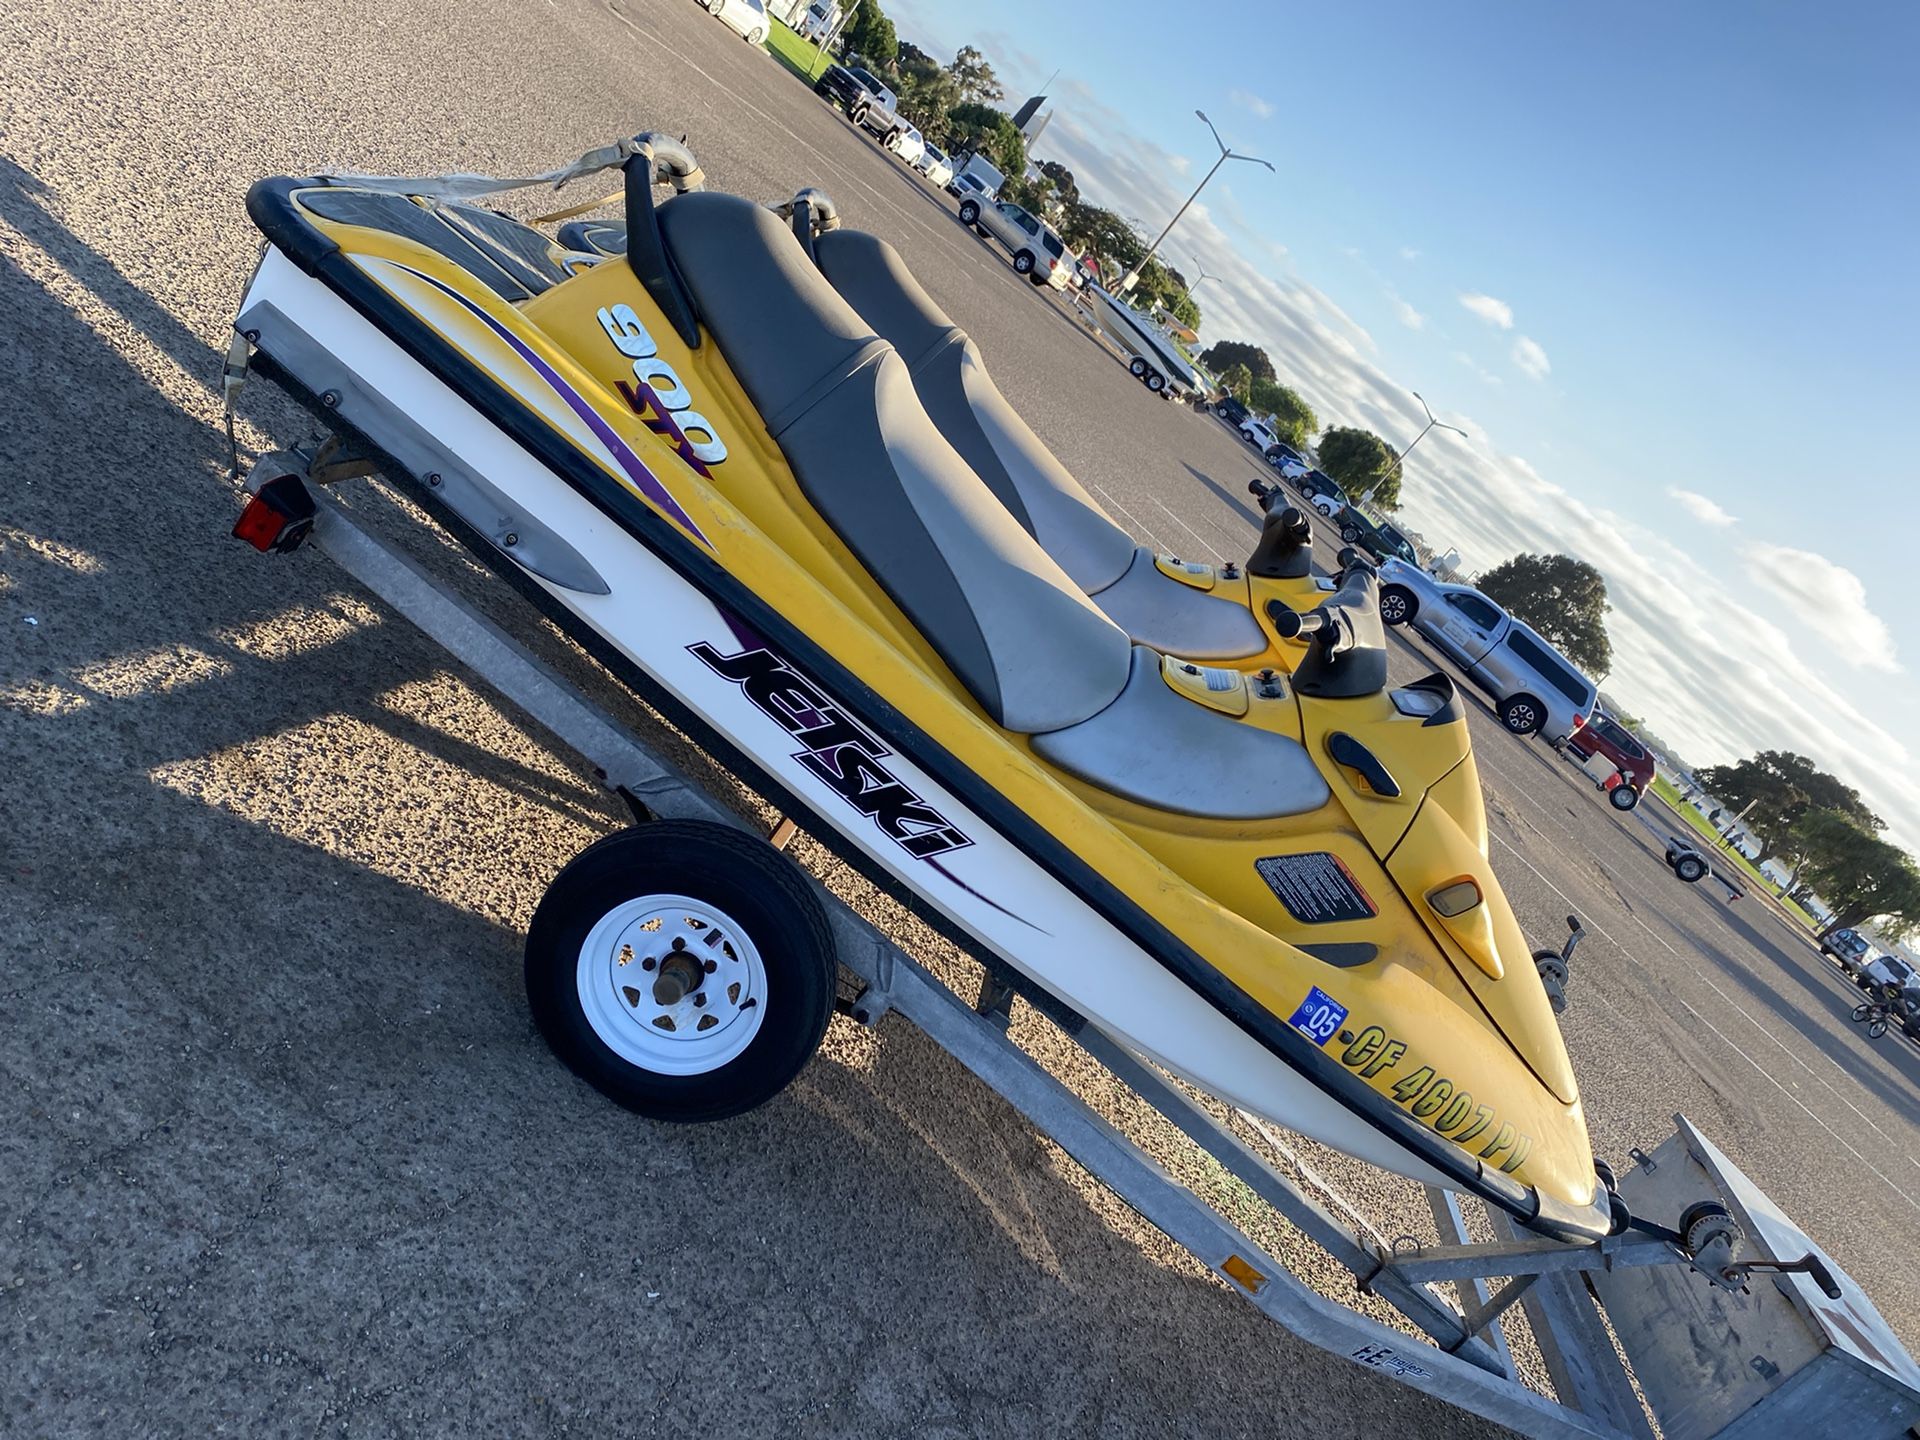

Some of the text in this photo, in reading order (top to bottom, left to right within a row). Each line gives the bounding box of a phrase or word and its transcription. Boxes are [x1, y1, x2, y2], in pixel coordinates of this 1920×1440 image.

[597, 304, 728, 466] 900
[1308, 1005, 1342, 1037] 05
[1341, 1025, 1408, 1079] CF
[1391, 1065, 1496, 1143] 4607
